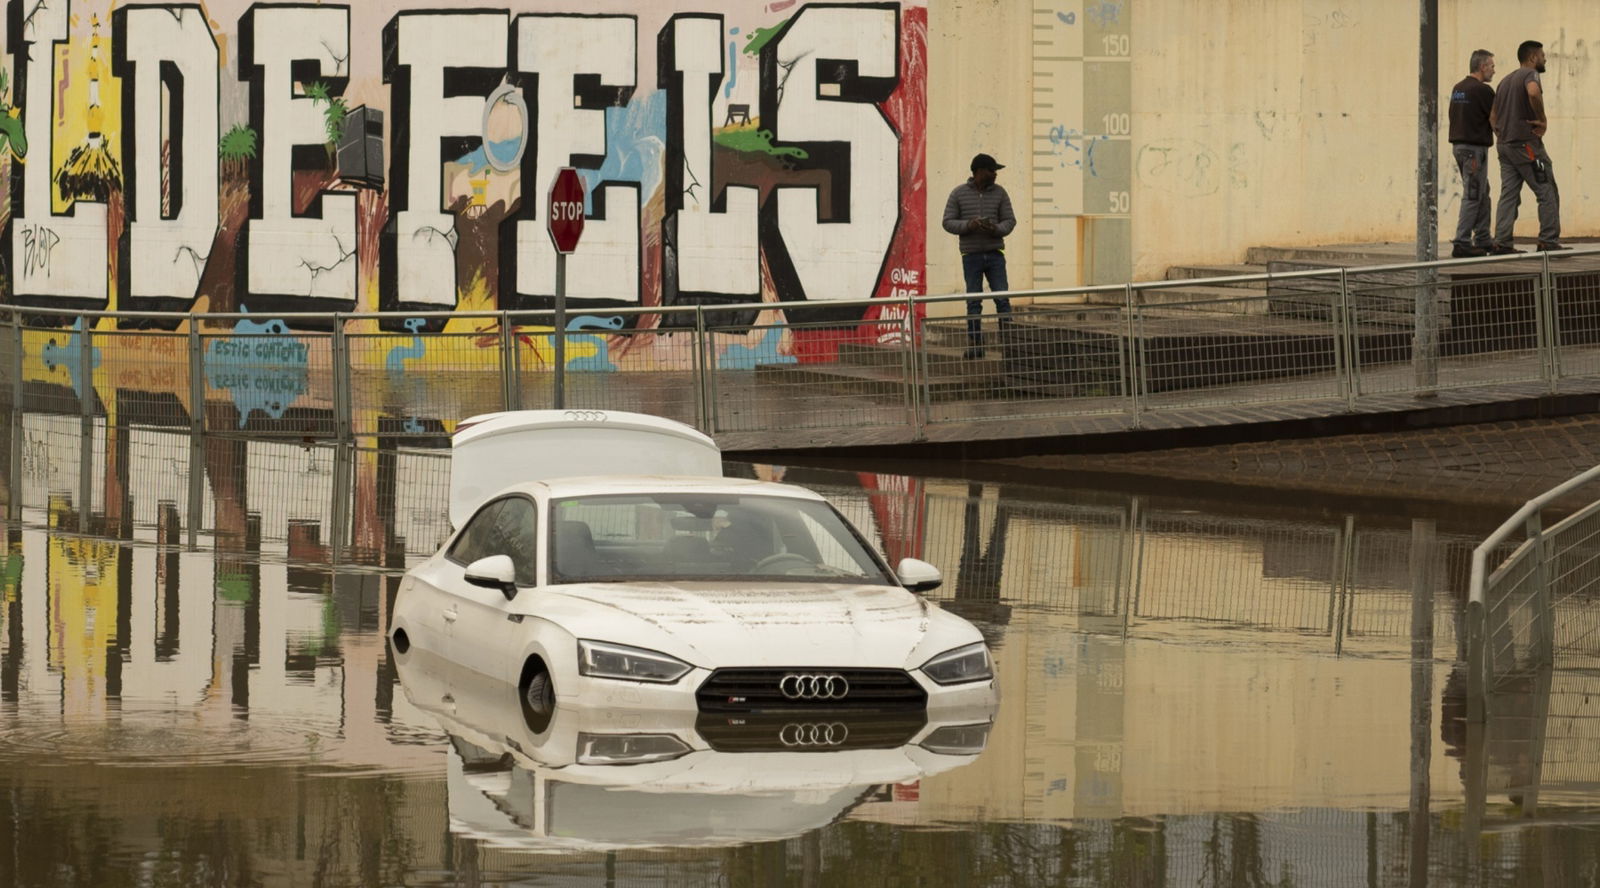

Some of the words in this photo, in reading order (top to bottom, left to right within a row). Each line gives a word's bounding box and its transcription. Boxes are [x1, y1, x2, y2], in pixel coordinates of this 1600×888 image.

[1102, 34, 1130, 56] 150
[1102, 113, 1130, 135] 100
[552, 201, 583, 221] STOP
[1109, 191, 1130, 213] 50
[891, 268, 919, 285] @WE
